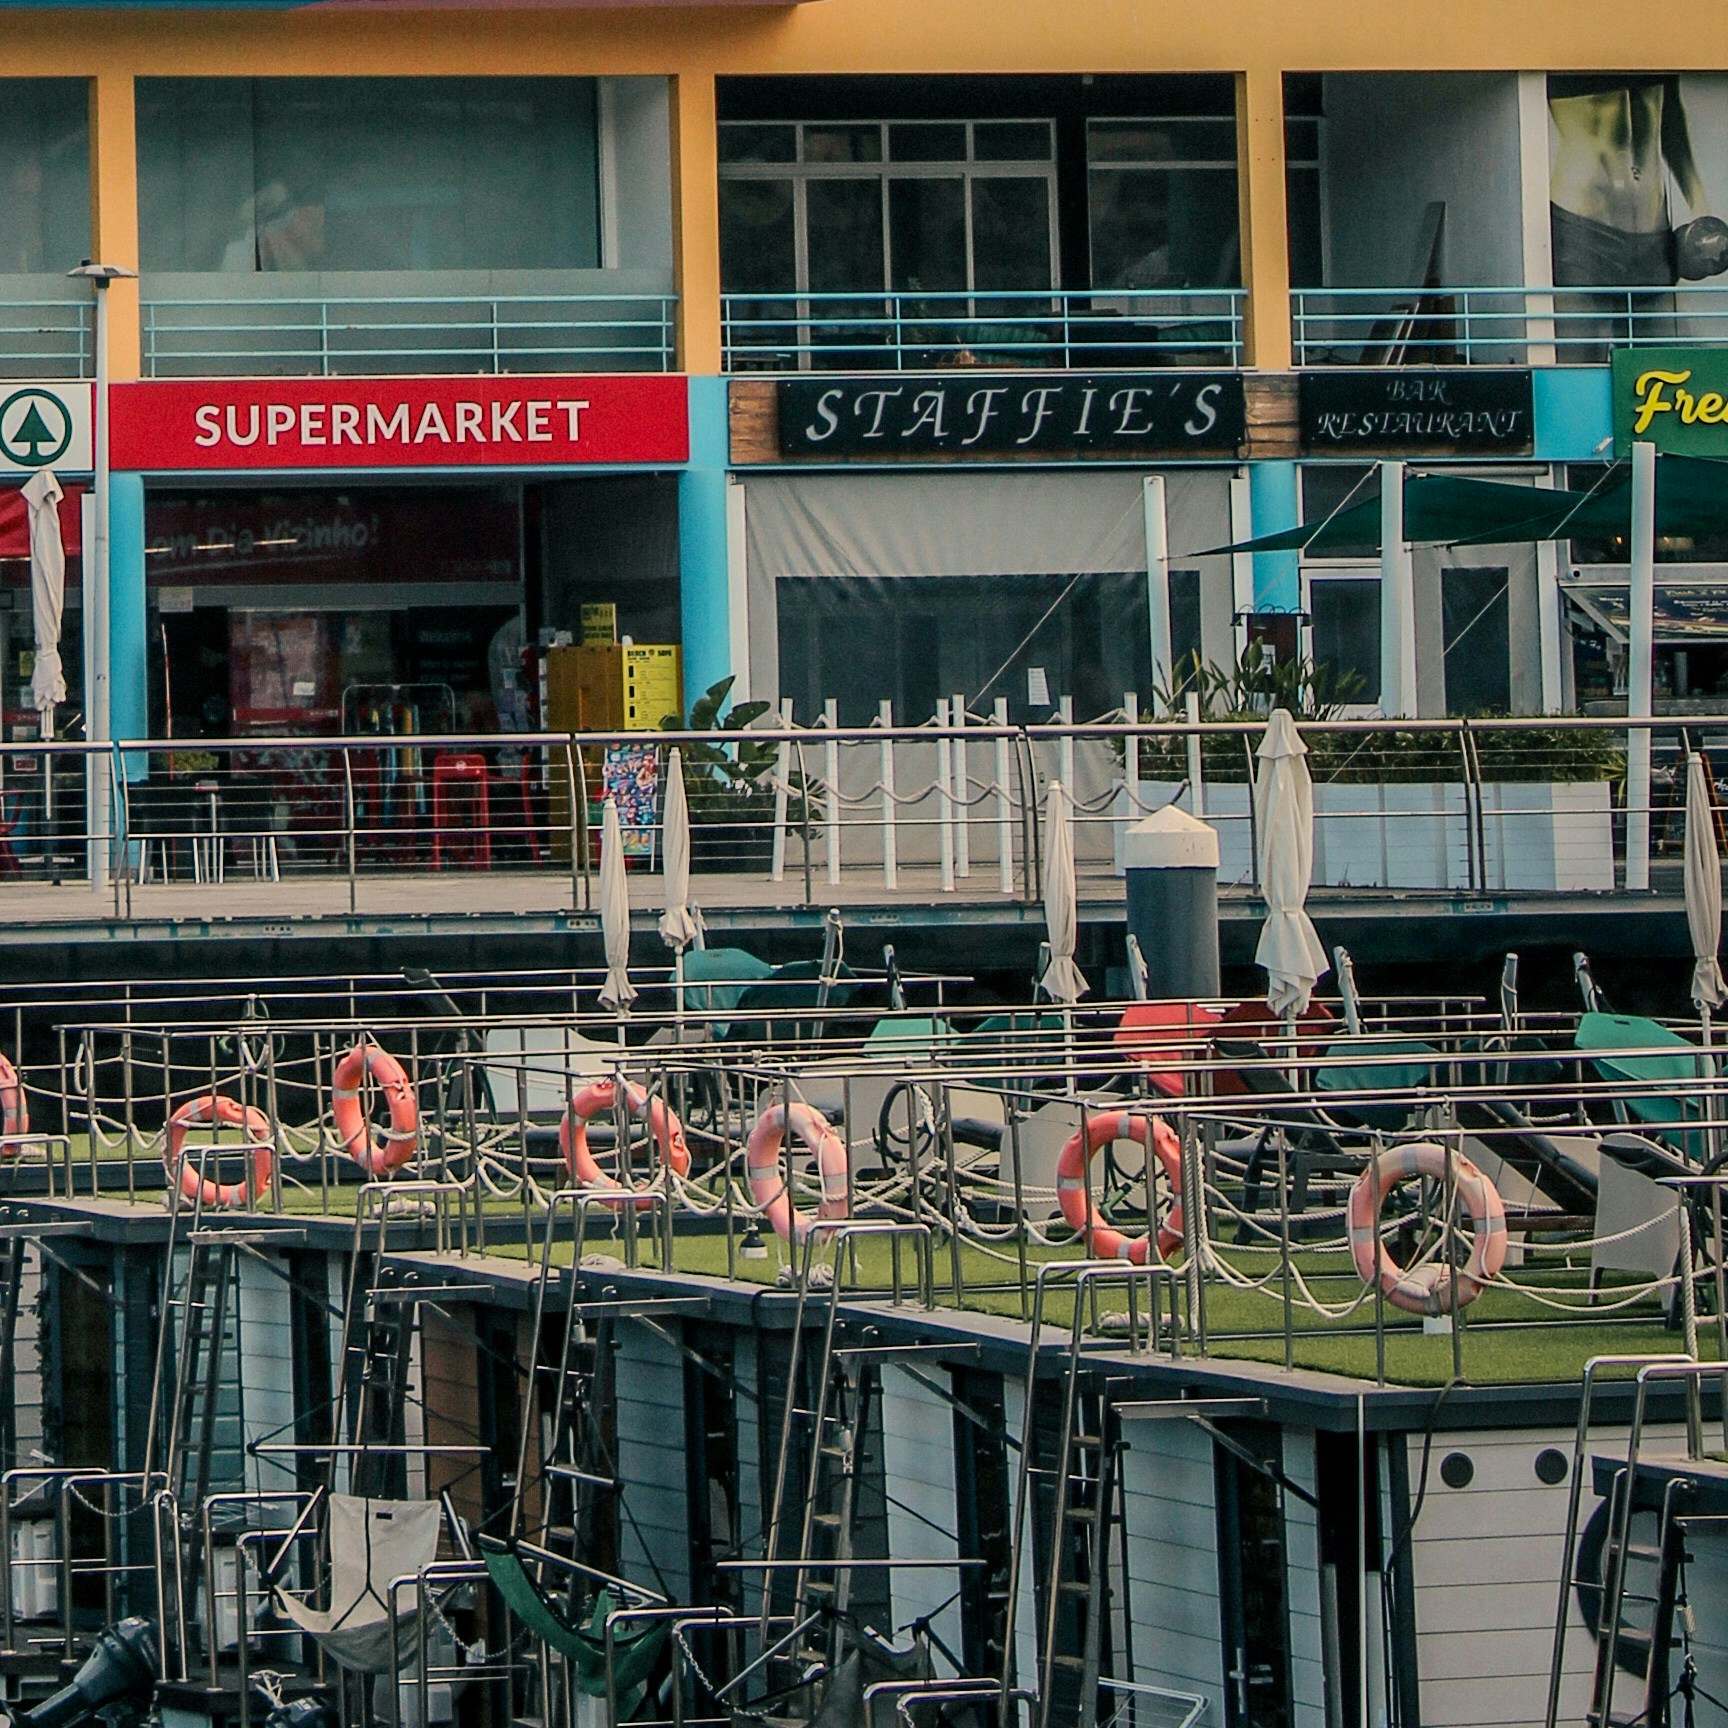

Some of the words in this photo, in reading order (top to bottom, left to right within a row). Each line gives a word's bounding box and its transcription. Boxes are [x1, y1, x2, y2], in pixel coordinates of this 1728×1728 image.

[1386, 379, 1452, 405] BAR
[1633, 370, 1728, 434] Fre
[193, 400, 590, 447] SUPERMARKET
[1318, 409, 1522, 440] RESTAURANT
[151, 532, 198, 558] om
[206, 524, 255, 556] Dia
